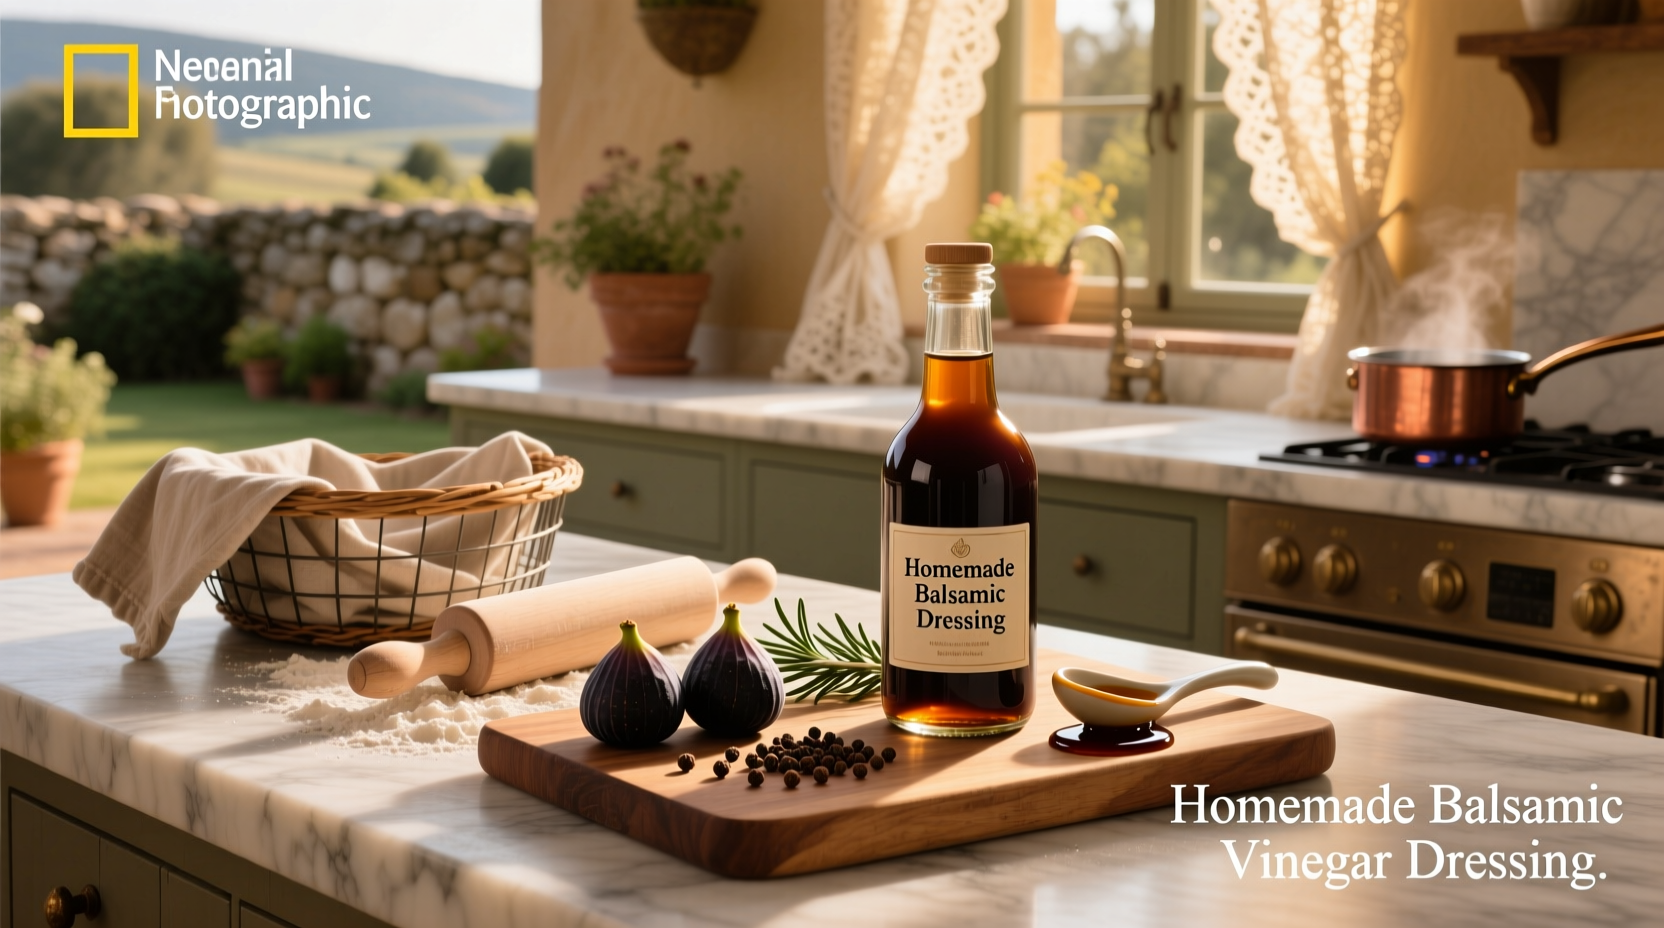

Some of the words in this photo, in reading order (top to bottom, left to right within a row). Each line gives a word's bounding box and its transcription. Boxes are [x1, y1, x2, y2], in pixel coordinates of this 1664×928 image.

[904, 557, 1015, 579] Homemade
[914, 583, 1006, 605] Balsamic
[916, 608, 1006, 635] Dressing
